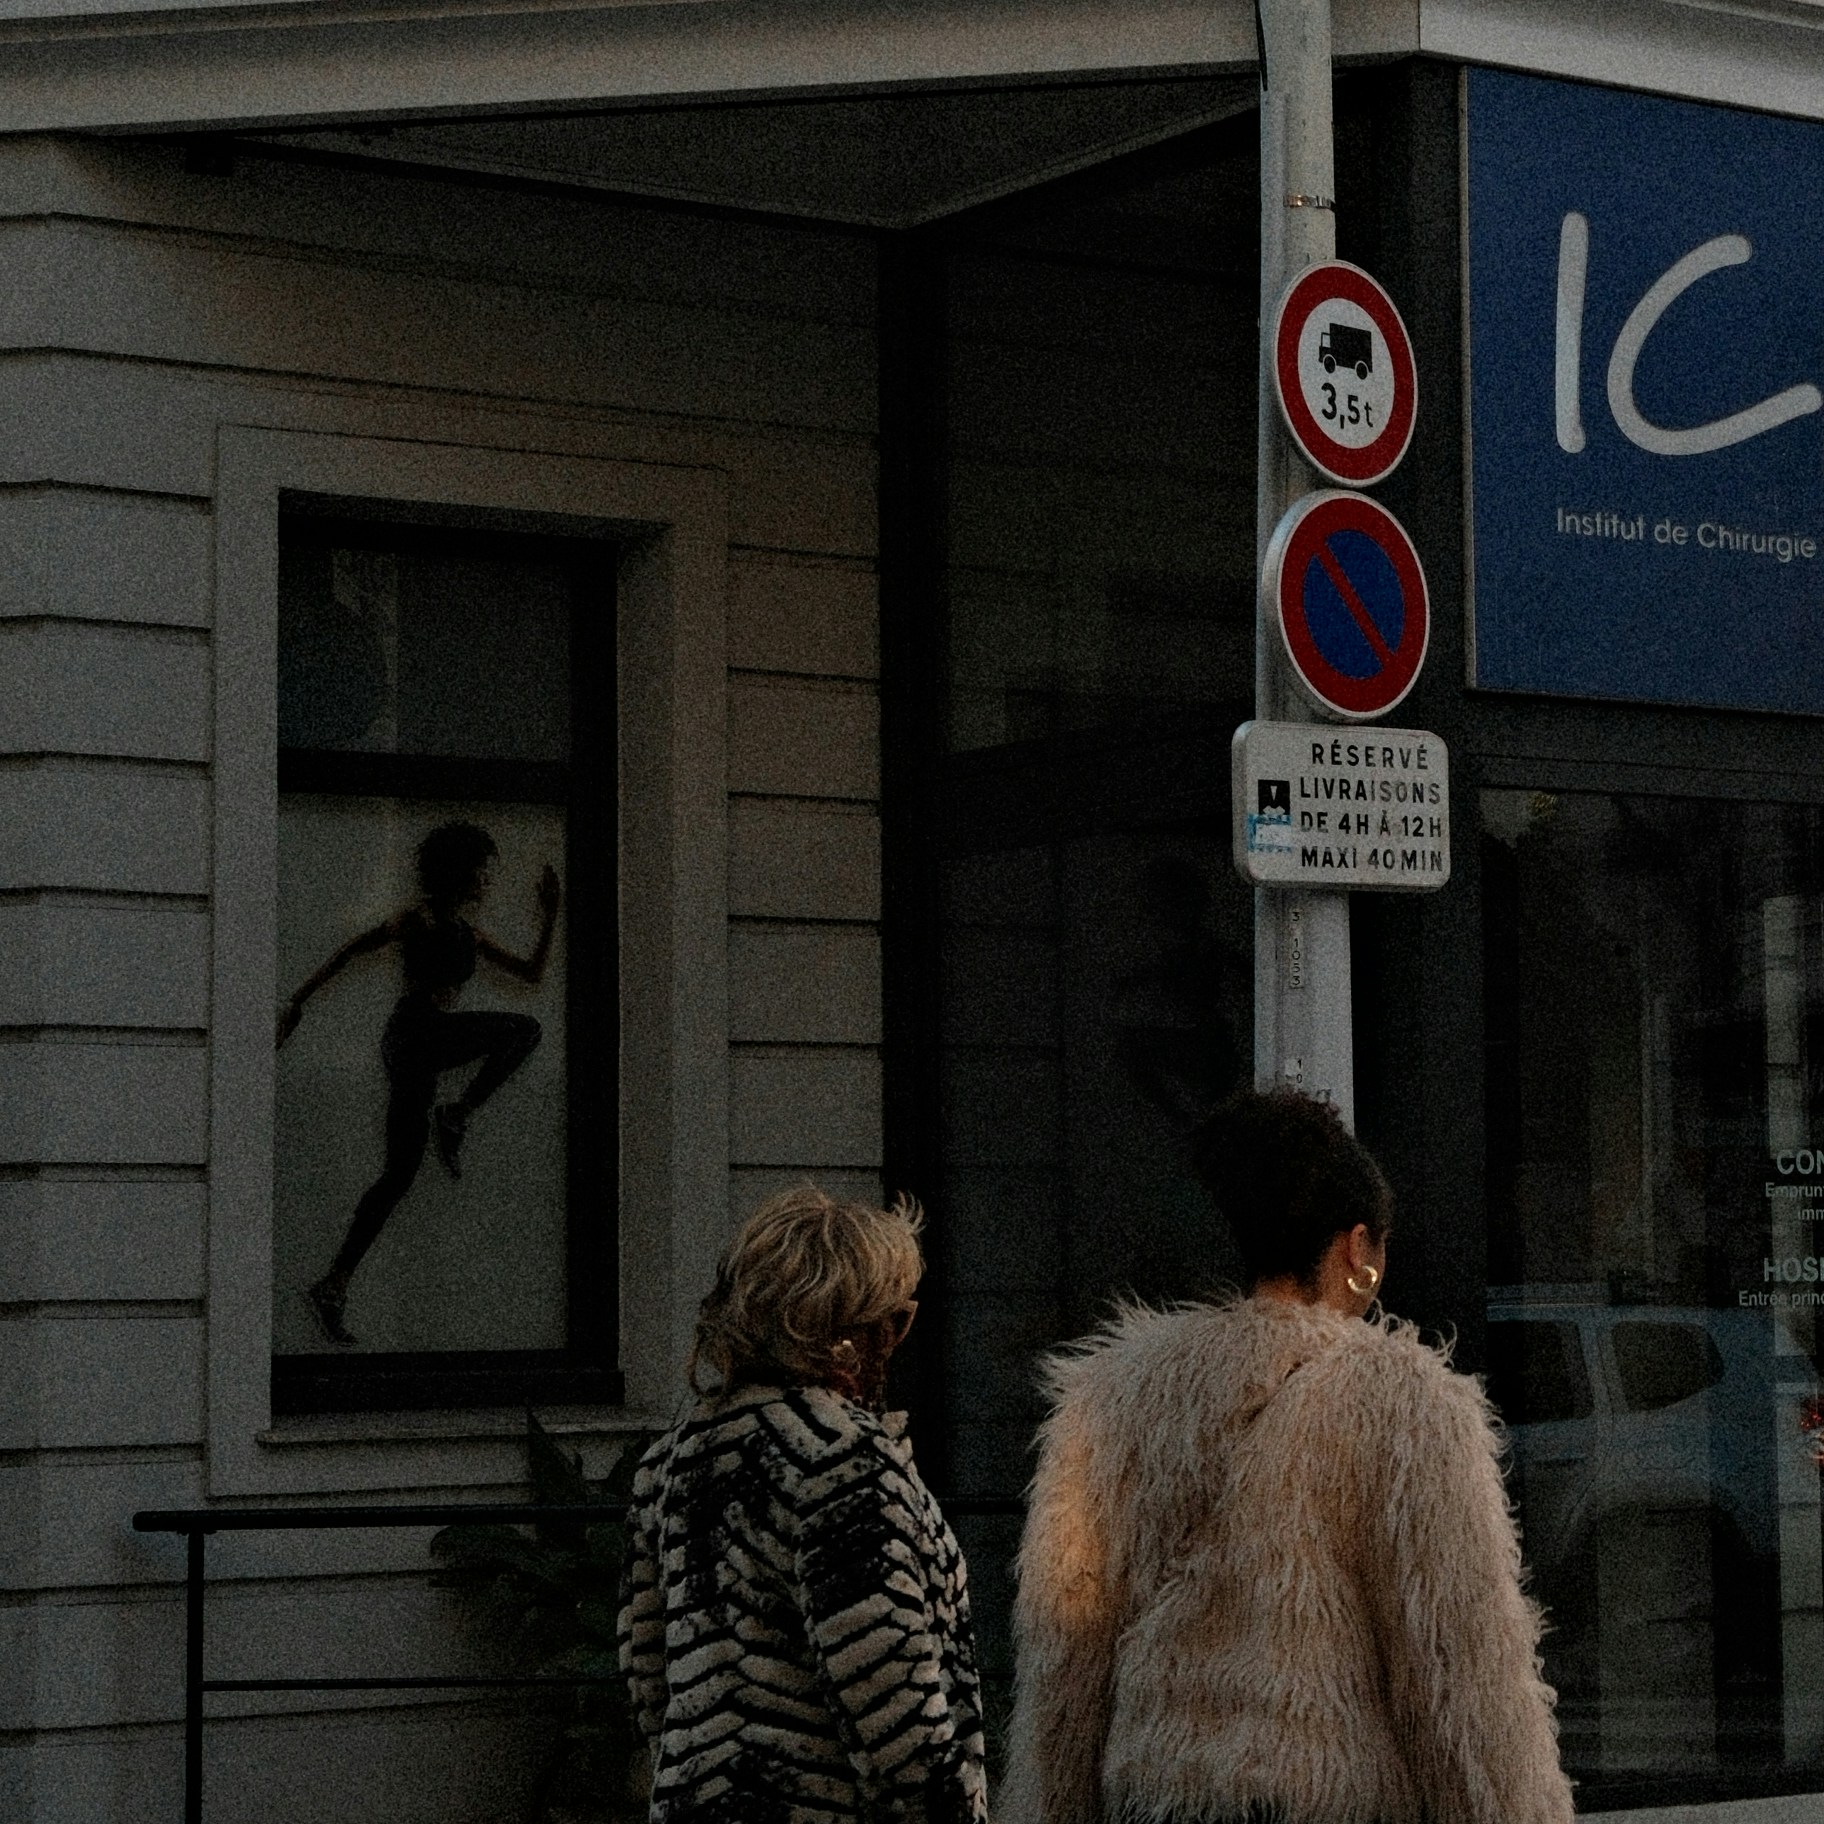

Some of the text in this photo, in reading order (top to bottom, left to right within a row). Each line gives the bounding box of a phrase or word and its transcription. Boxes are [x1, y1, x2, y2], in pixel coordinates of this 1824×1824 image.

[1555, 508, 1646, 542] Institut
[1653, 520, 1690, 545] de
[1697, 523, 1818, 563] Chirurgie
[1312, 739, 1429, 770] RÉSERVÉ
[1300, 777, 1441, 804] LIVRAISONS
[1301, 812, 1329, 834] DE
[1302, 846, 1358, 868] MAXI
[1738, 1289, 1787, 1307] Entrée
